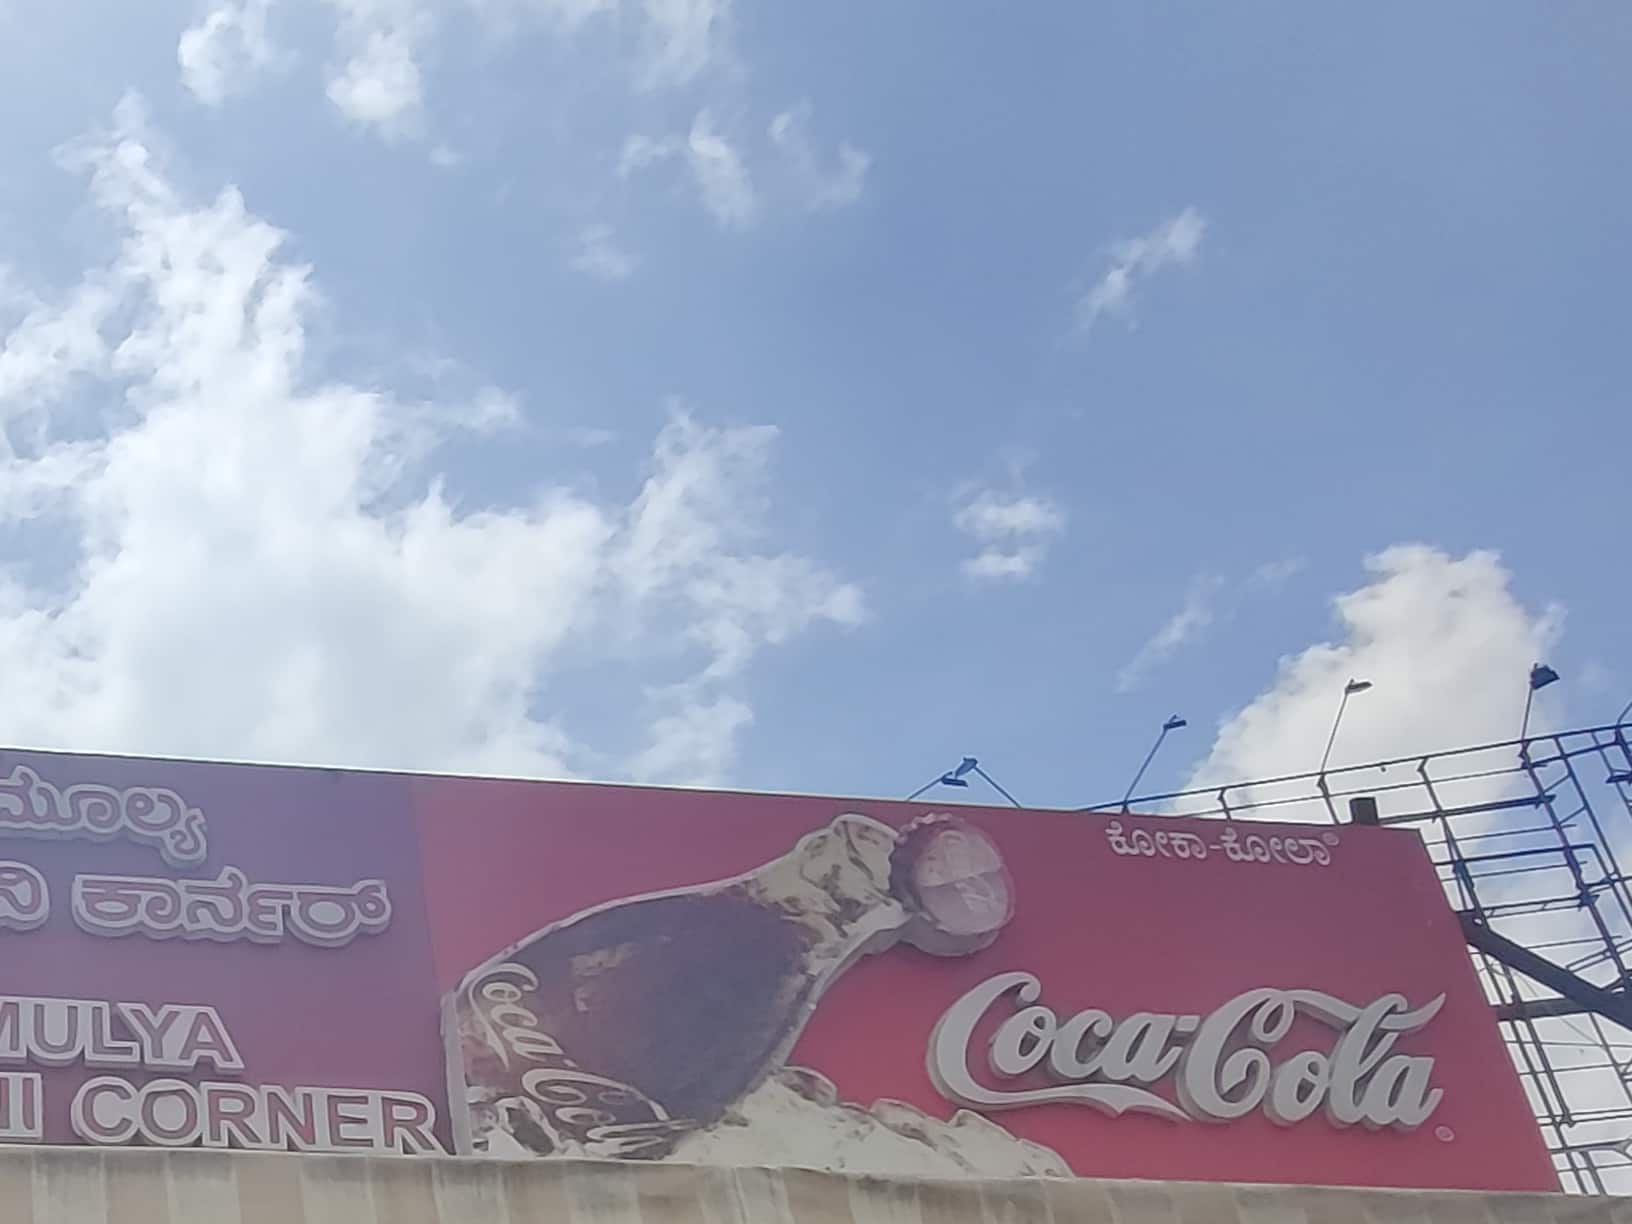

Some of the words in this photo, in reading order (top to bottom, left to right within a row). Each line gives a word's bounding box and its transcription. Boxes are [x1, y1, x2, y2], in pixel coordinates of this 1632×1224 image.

[71, 866, 392, 947] ಕಾರ್ನರ್
[926, 971, 1446, 1133] Coca-Cola
[70, 1075, 458, 1157] CORNER
